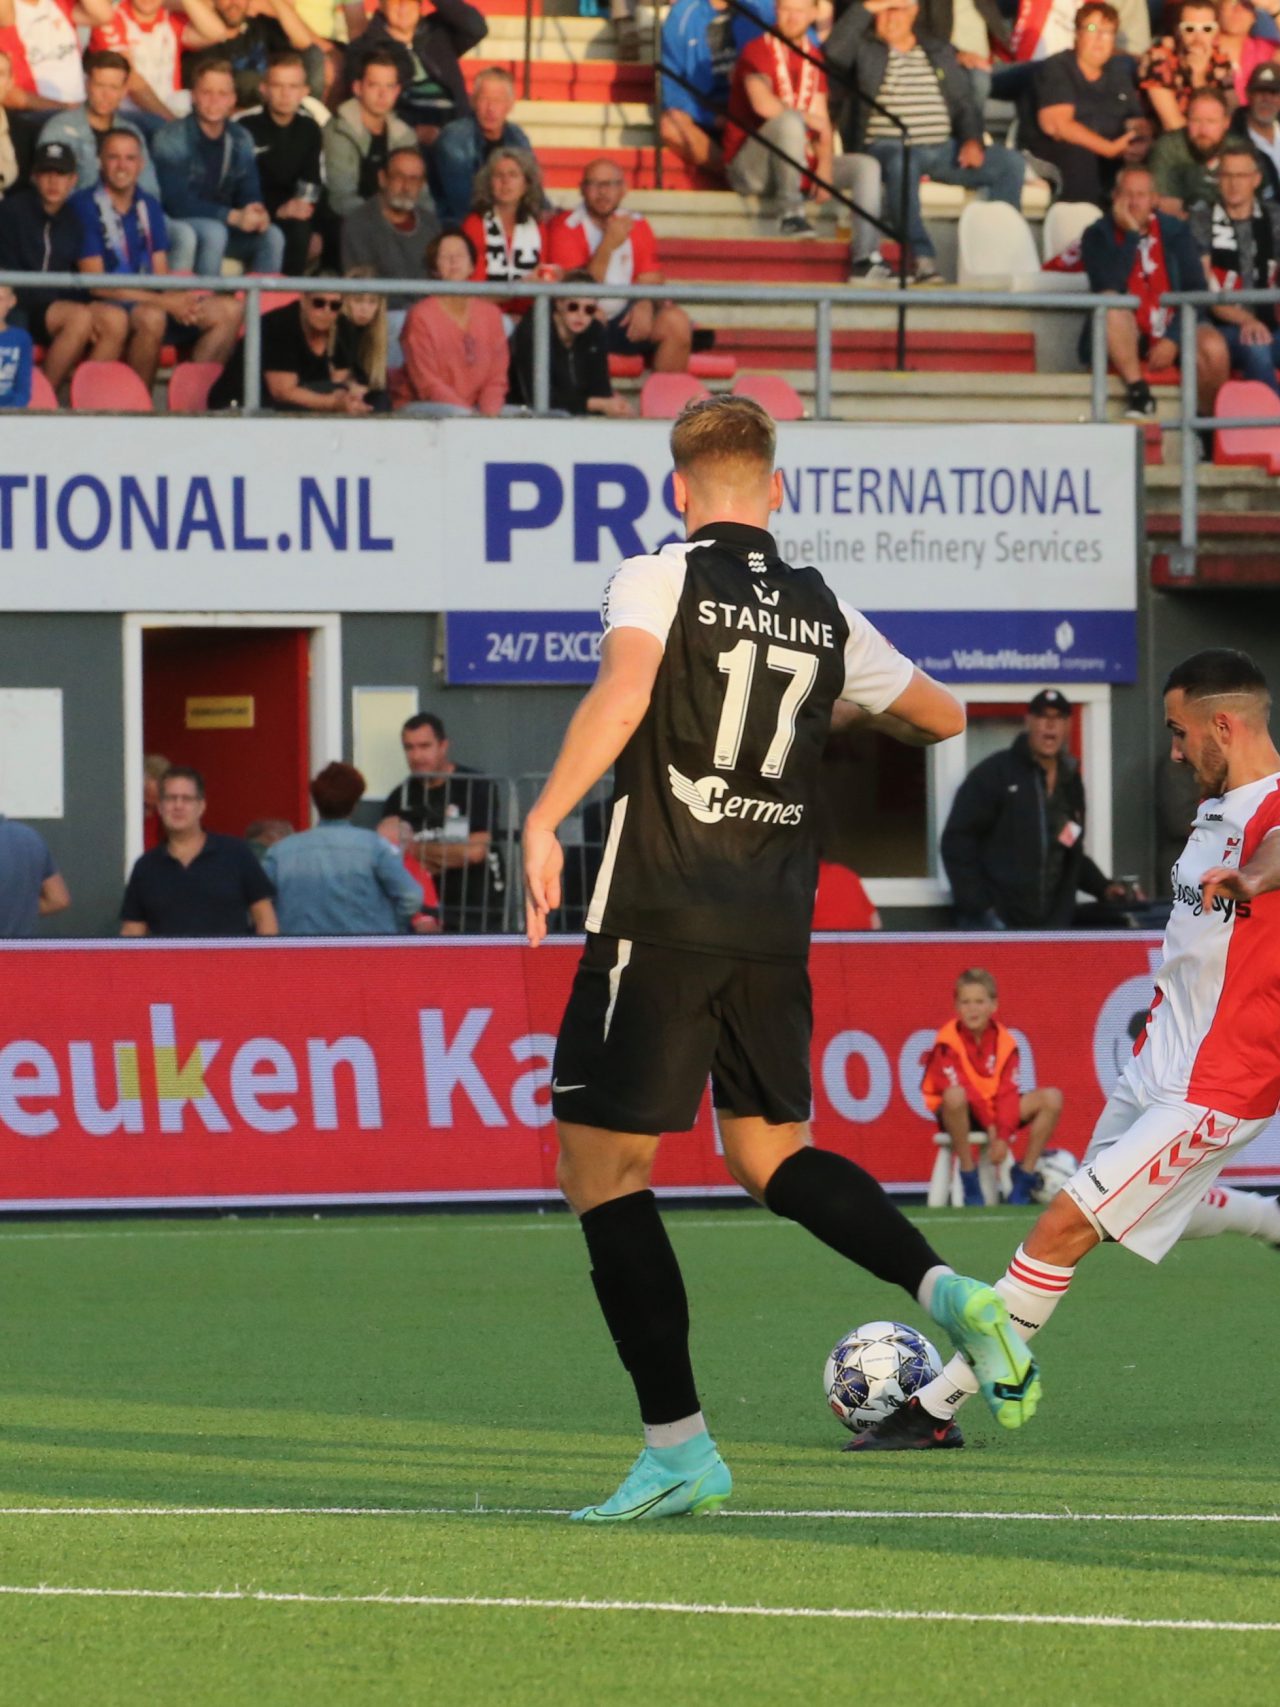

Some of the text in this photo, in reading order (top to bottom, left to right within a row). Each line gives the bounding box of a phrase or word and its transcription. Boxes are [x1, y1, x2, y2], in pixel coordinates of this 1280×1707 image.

[484, 463, 687, 563] PR
[777, 467, 1102, 515] NTERNATIONAL
[775, 530, 1103, 570] ipeline Refinery Services
[486, 632, 539, 662] 24/7
[698, 600, 835, 648] STARLINE
[713, 639, 819, 779] 17
